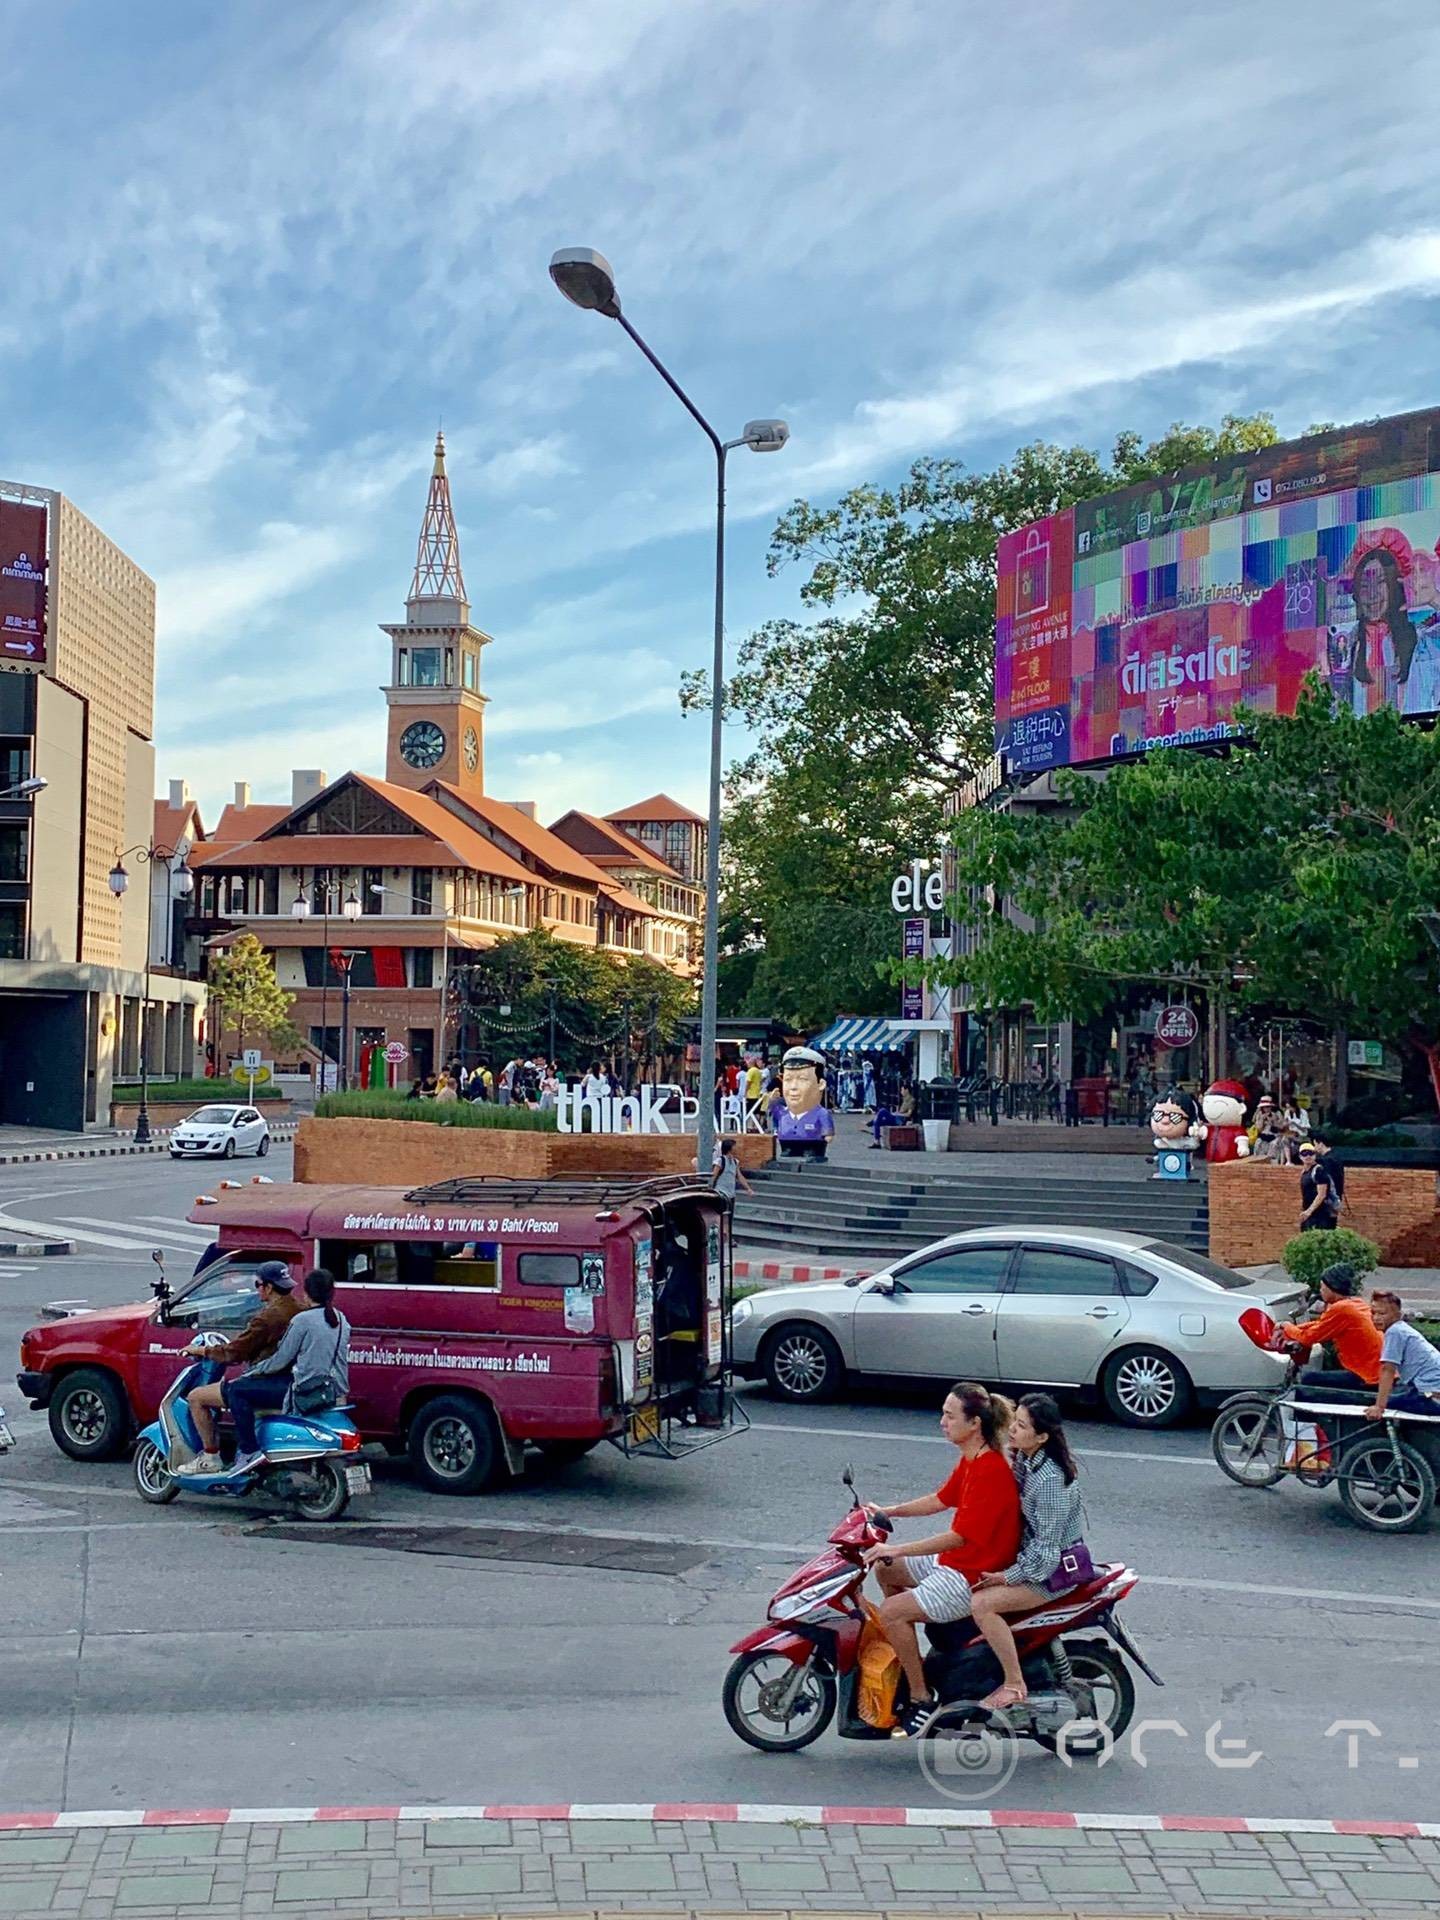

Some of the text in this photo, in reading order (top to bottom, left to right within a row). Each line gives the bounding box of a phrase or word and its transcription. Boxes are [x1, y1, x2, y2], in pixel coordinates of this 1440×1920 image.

[1284, 583, 1313, 614] 48
[1168, 1011, 1187, 1024] 24
[1161, 1028, 1193, 1038] OPEN
[554, 1083, 765, 1134] think PRK
[433, 1218, 446, 1231] 30
[487, 1219, 499, 1232] 30
[501, 1218, 560, 1234] Baht/Person
[506, 1358, 513, 1371] 2
[514, 1352, 550, 1373] เชียงใหม่
